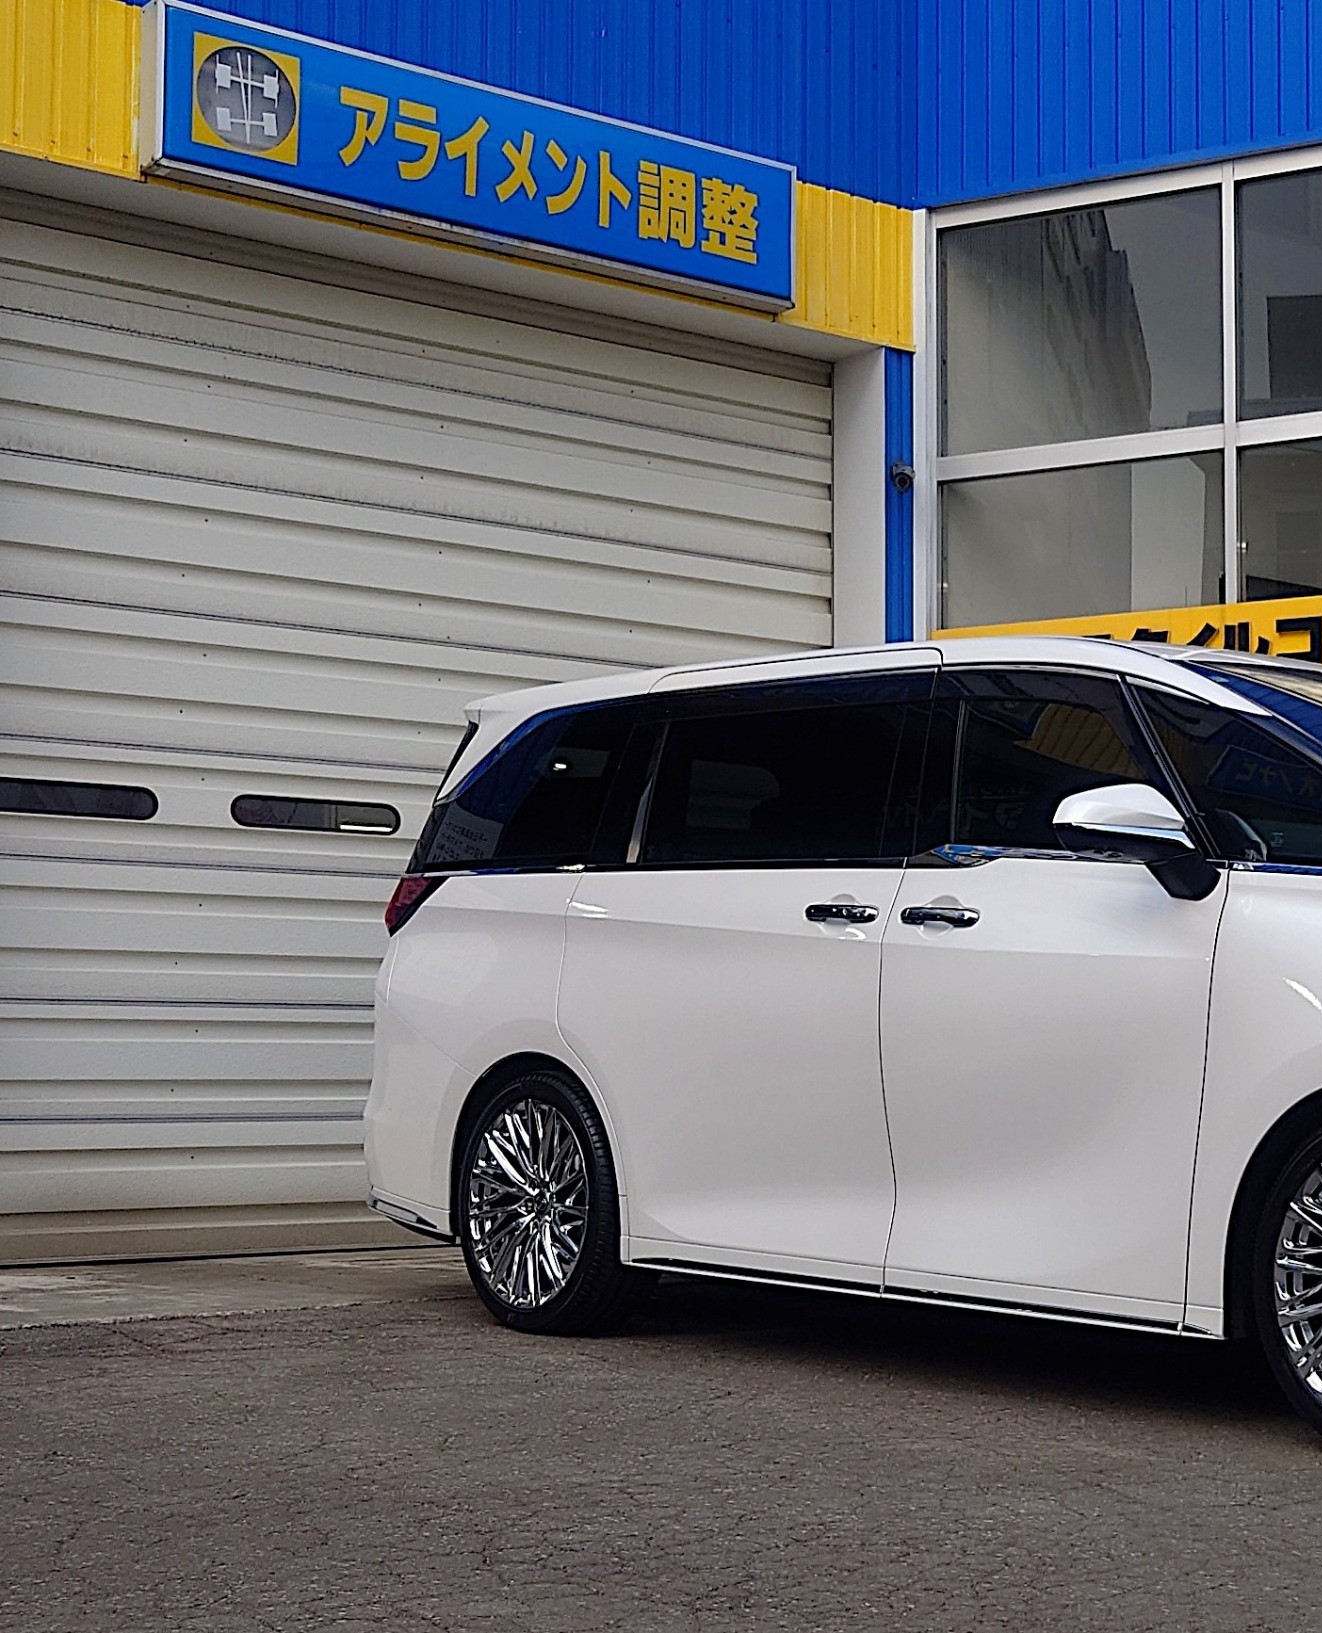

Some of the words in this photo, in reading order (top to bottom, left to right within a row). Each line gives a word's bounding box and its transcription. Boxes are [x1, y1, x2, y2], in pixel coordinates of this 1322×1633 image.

[339, 86, 760, 265] アライメント調整
